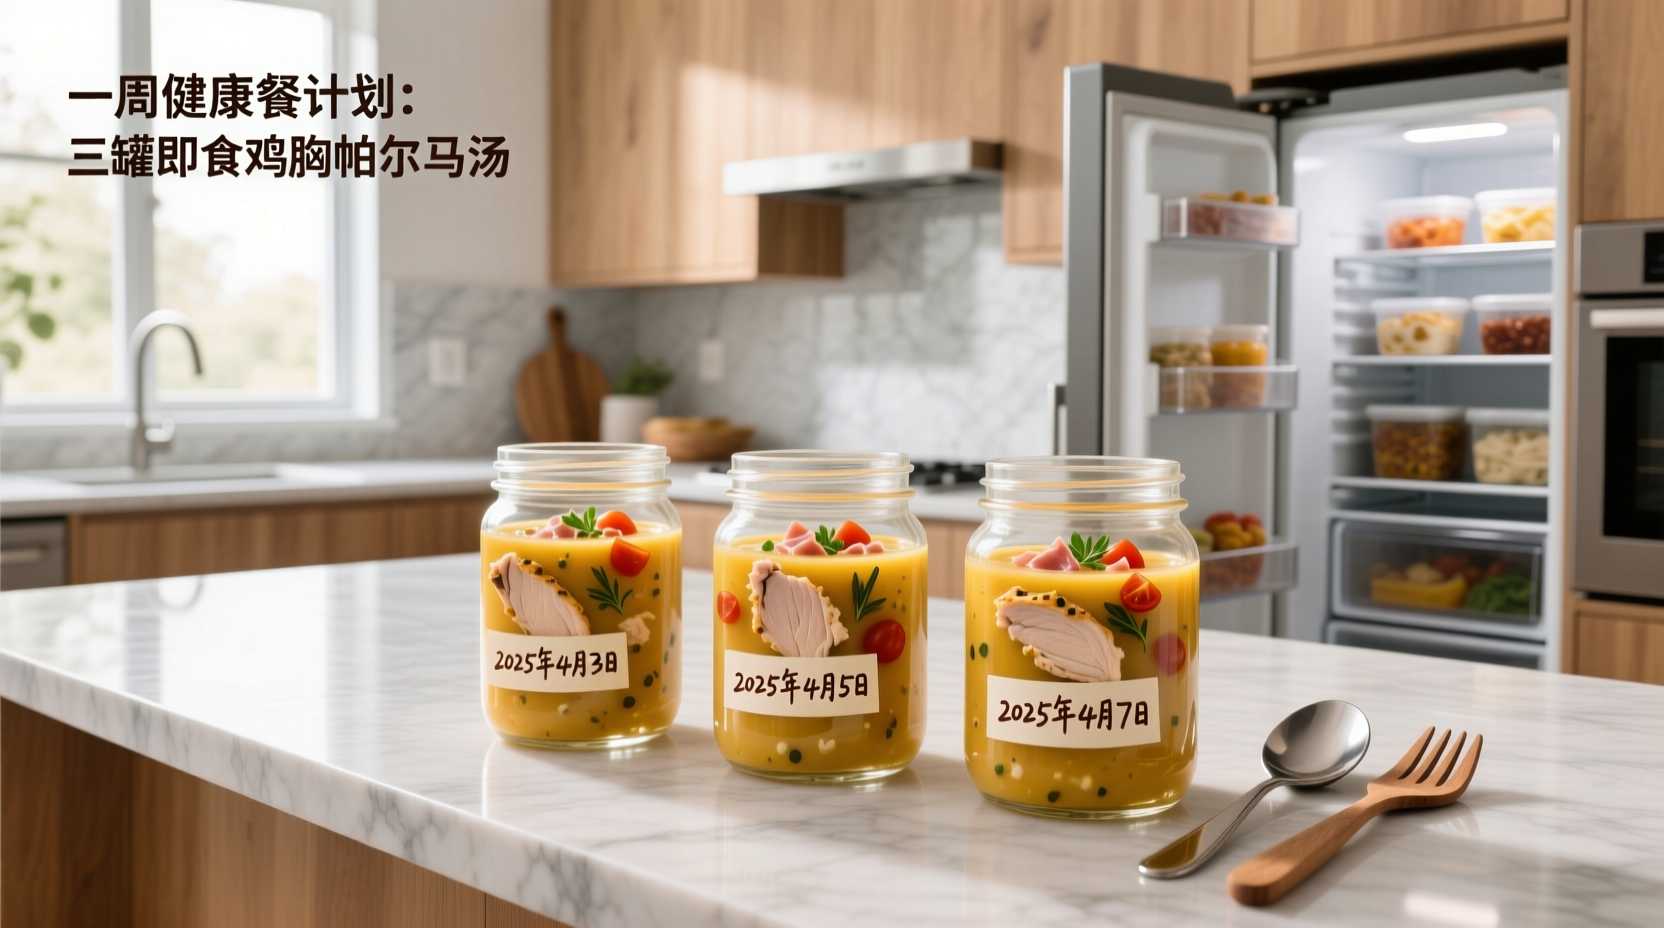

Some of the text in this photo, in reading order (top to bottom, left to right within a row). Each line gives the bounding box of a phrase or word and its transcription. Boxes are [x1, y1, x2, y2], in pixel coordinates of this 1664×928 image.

[494, 646, 618, 681] 2025年4月3日
[733, 667, 868, 706] 2025年4月5日
[998, 694, 1149, 735] 2025年4月7日
